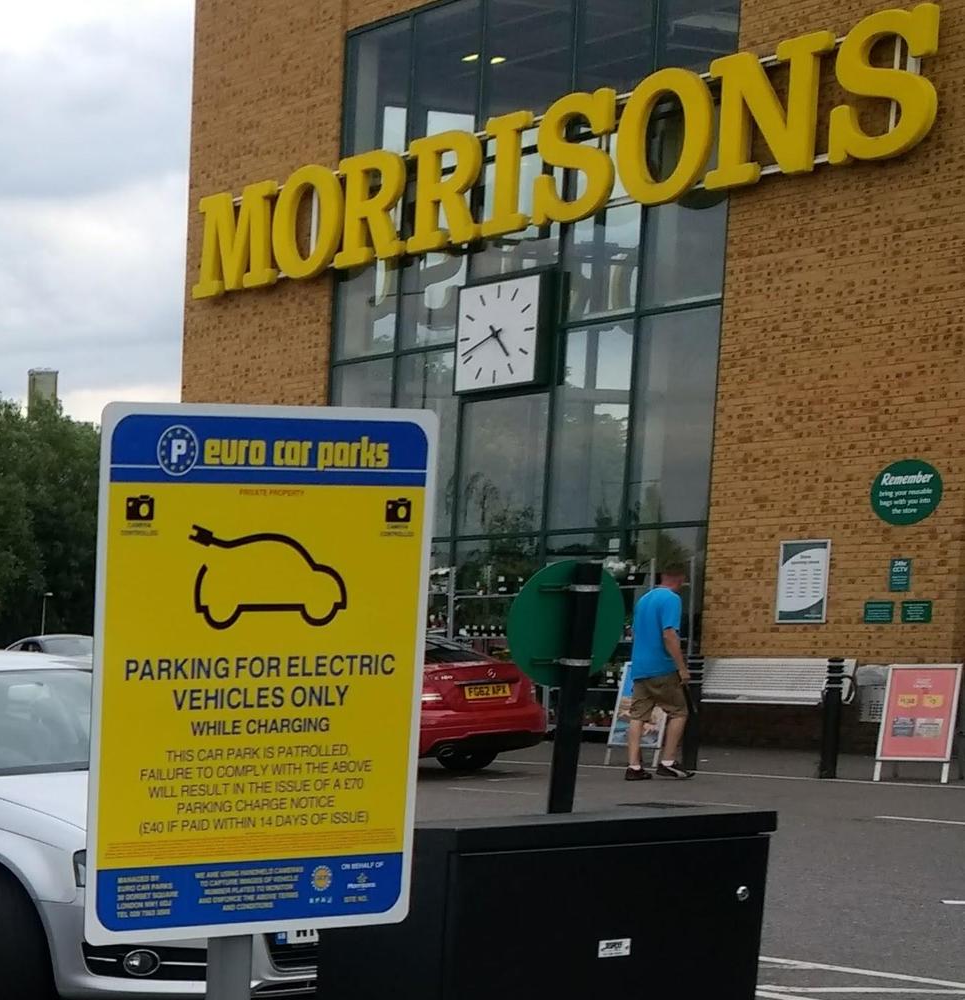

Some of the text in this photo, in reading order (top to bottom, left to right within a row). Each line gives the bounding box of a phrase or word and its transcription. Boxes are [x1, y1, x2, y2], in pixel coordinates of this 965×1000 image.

[191, 2, 941, 300] MORRISONS
[170, 436, 390, 471] P euro car parks
[880, 471, 934, 486] Remember
[879, 490, 893, 498] bring
[879, 499, 892, 507] bags
[907, 498, 919, 506] you
[125, 654, 396, 681] PARKING FOR ELECTRIC
[172, 685, 349, 711] VEHICLES ONLY
[468, 687, 490, 697] FG62
[191, 717, 330, 736] WHILE CHARGING
[166, 750, 194, 763] THIS
[197, 749, 224, 761] CAR
[227, 748, 260, 760] PARK
[263, 747, 274, 759] IS
[139, 760, 372, 781] FAILURE TO COMPLY WITH THE ABOVE
[148, 778, 364, 799] WILL RESULT IN THE ISSUE OF A £70
[176, 796, 335, 815] PARKING CHARGE NOTICE
[138, 811, 369, 837] (£40 IF PAID WITHIN 14 DAYS OF ISSUE)
[351, 862, 374, 870] BEHALF
